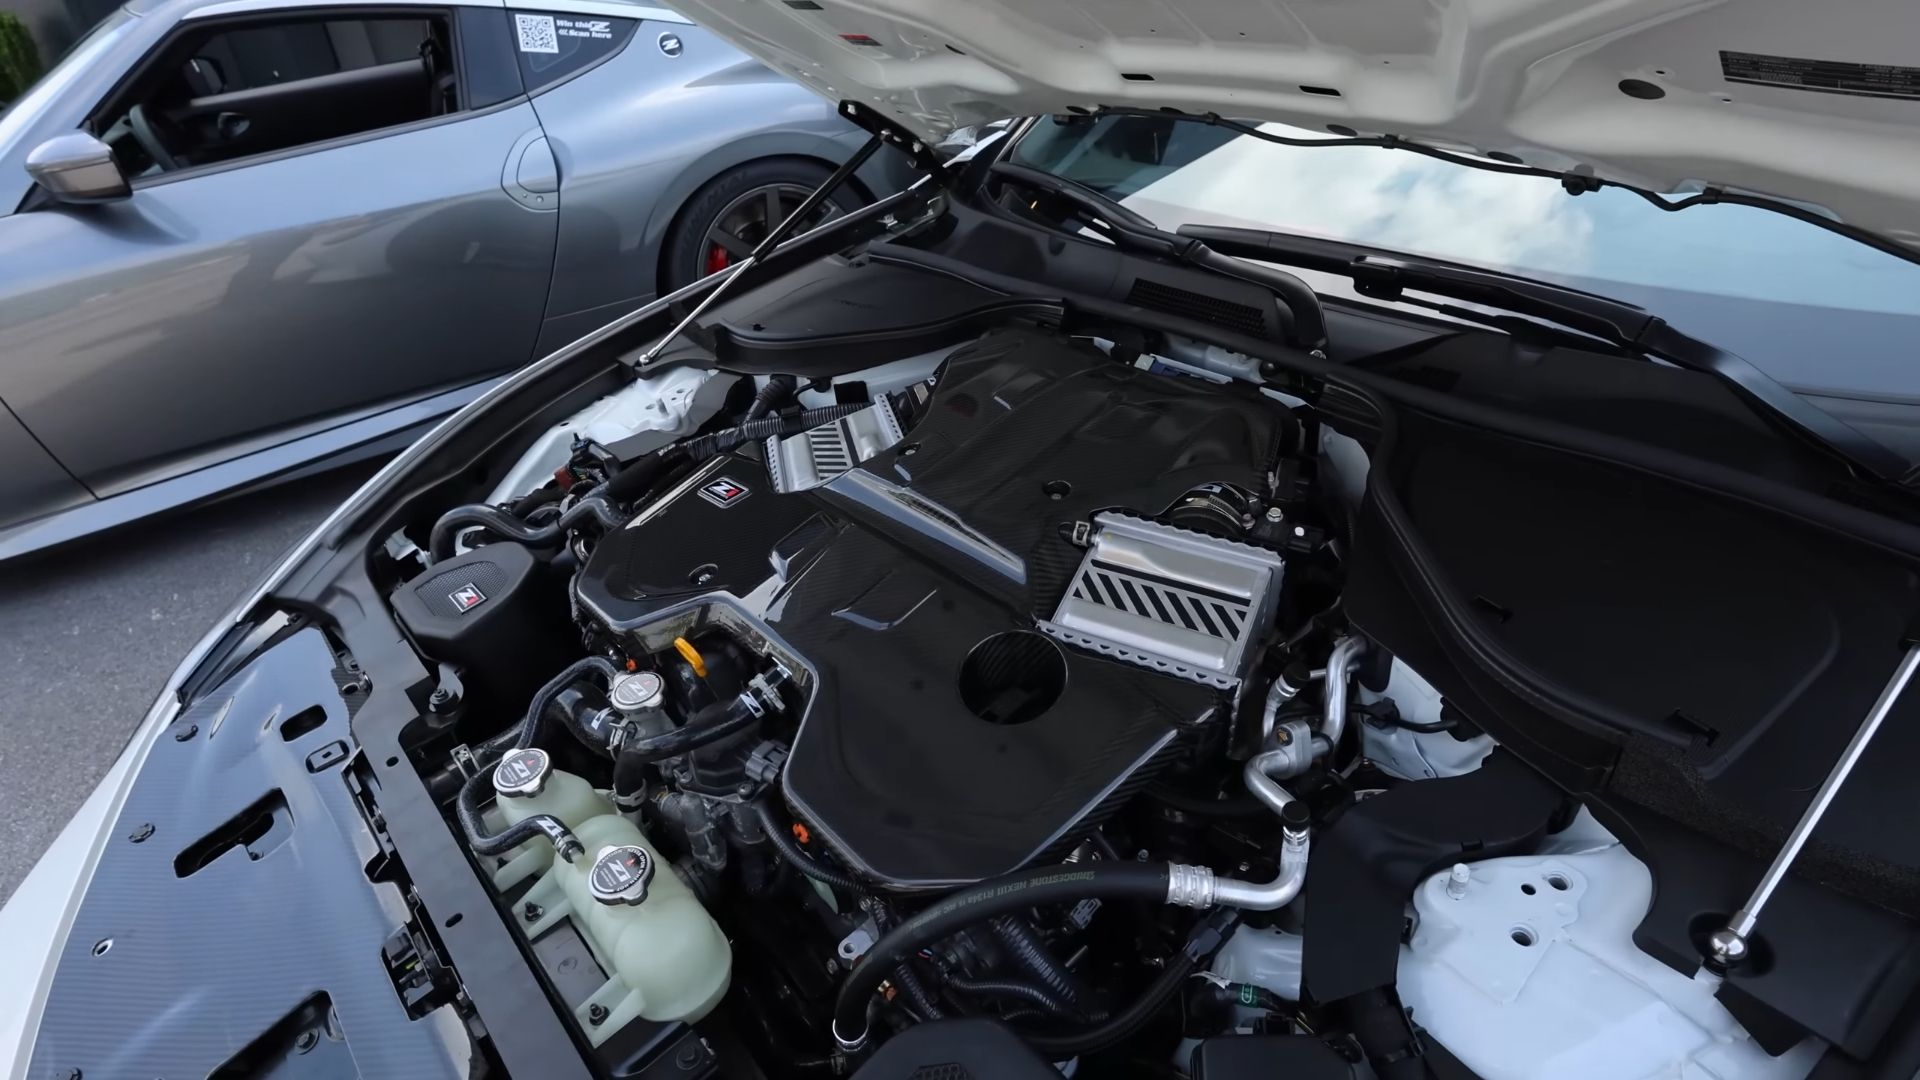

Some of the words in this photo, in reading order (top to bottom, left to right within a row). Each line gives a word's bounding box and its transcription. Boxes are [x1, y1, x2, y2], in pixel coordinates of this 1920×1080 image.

[556, 19, 573, 28] Win
[569, 29, 590, 38] Scan
[591, 31, 613, 40] here
[1029, 870, 1096, 886] BRIDGESTONE
